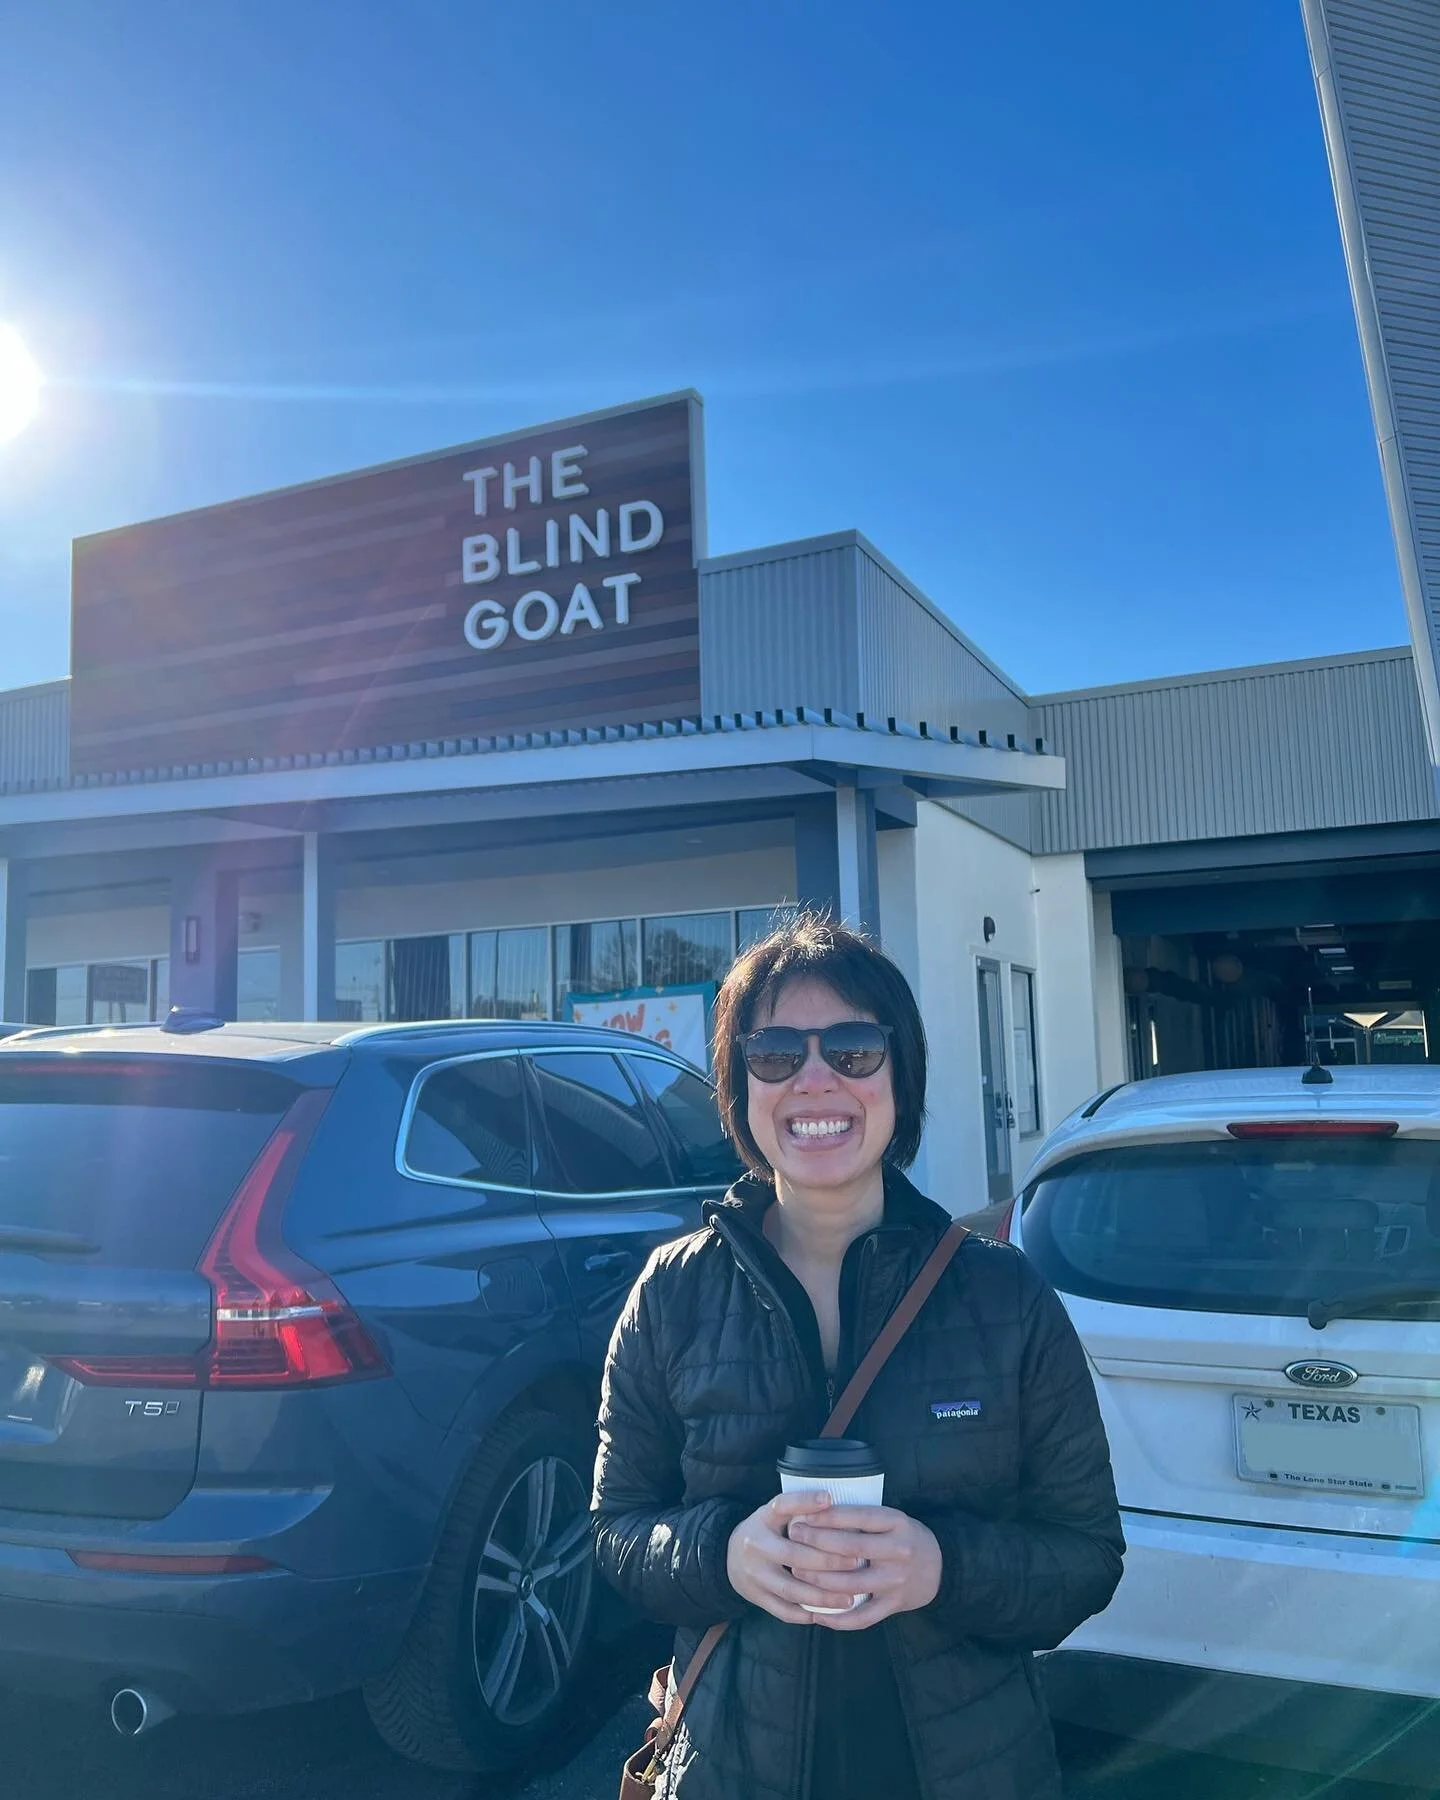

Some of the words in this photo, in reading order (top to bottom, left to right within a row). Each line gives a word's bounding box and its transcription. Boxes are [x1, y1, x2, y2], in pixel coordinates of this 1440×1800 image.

[462, 444, 589, 517] THE
[462, 500, 664, 584] BLIND
[463, 572, 642, 650] GOAT
[602, 1003, 645, 1033] OW
[1301, 1366, 1341, 1383] Ford
[936, 1408, 979, 1419] patagonia
[1287, 1403, 1360, 1424] TEXAS
[1284, 1473, 1301, 1481] The
[1303, 1475, 1325, 1484] Lone
[1327, 1477, 1346, 1485] Star
[1348, 1479, 1373, 1488] State
